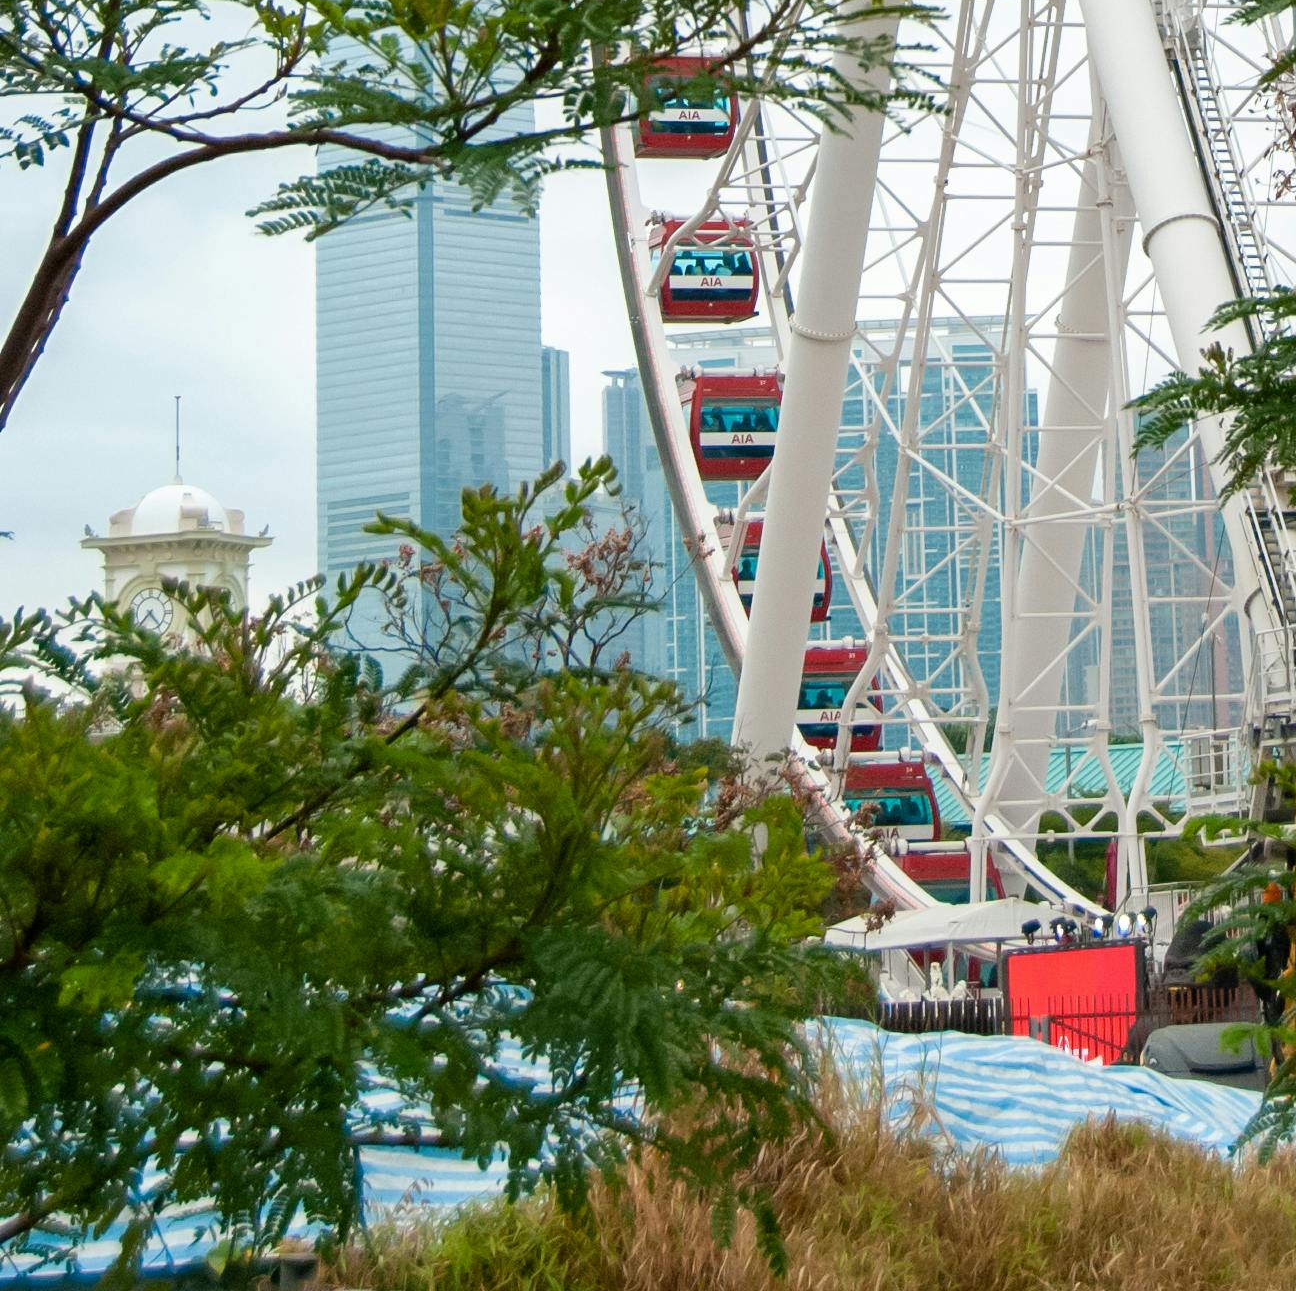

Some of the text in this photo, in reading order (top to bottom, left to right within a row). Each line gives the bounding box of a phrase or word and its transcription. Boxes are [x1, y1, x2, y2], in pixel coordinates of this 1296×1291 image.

[678, 109, 701, 121] AIA
[700, 274, 723, 287] AIA
[731, 433, 755, 446] AIA
